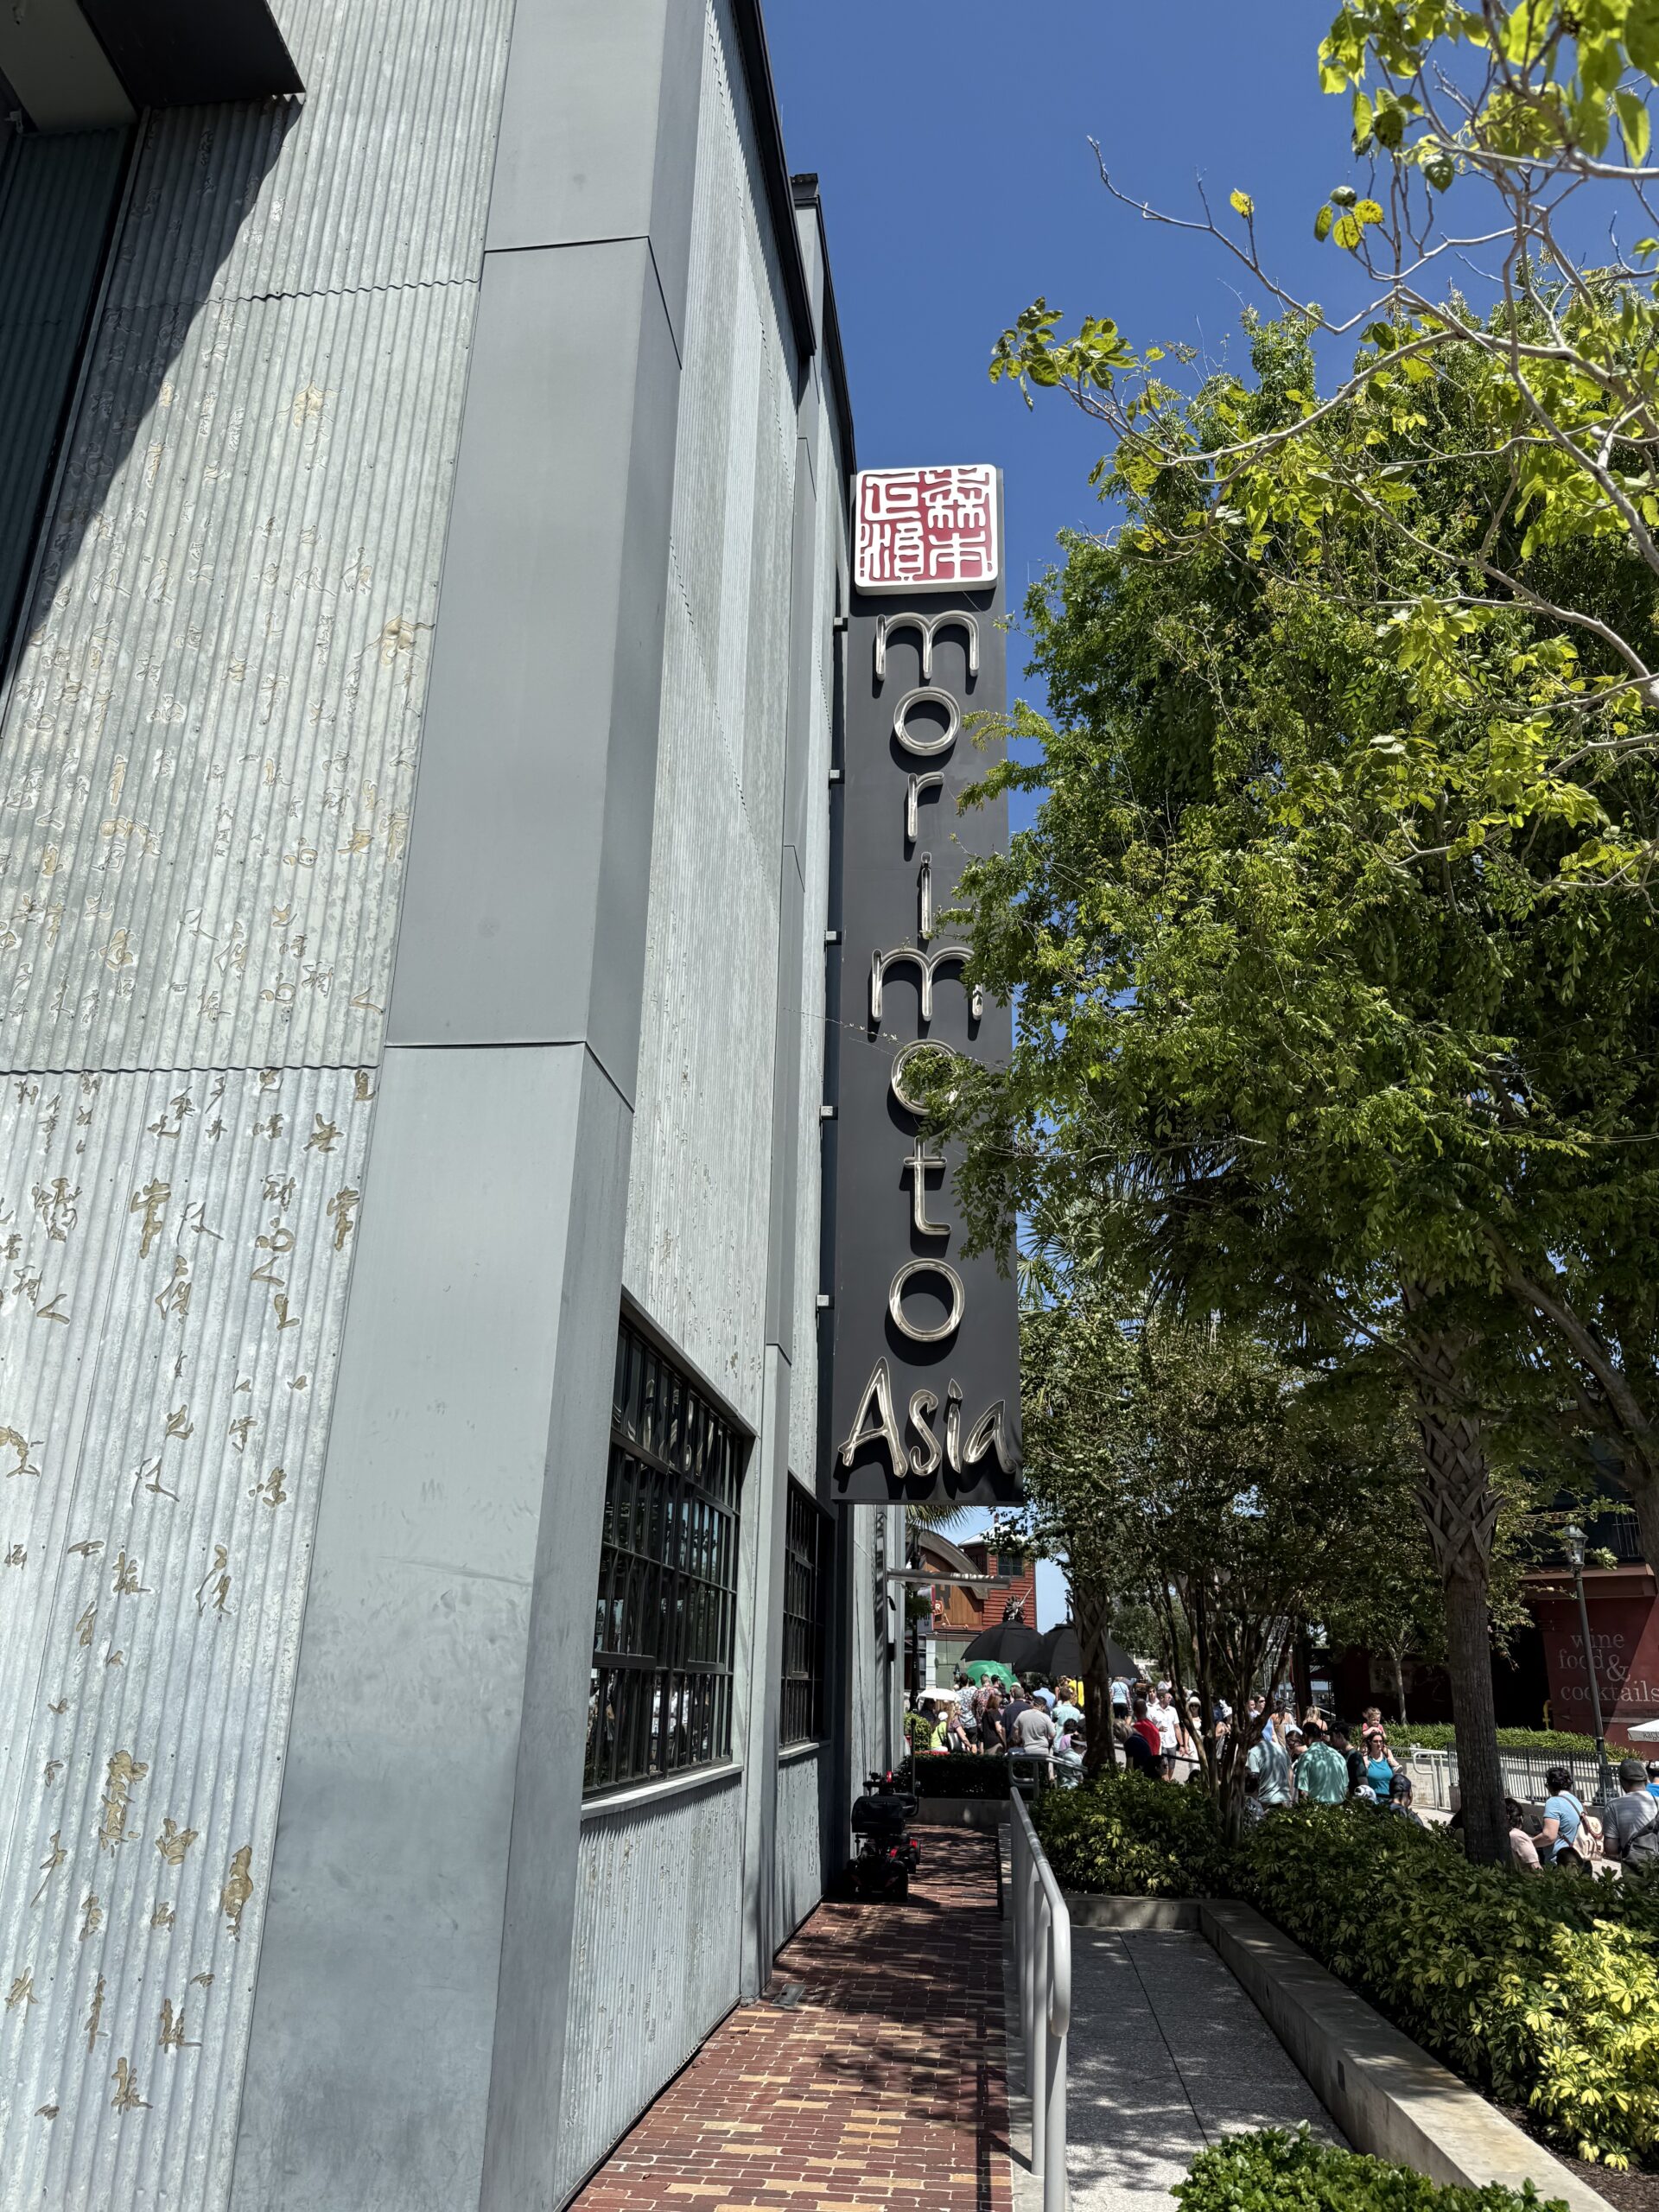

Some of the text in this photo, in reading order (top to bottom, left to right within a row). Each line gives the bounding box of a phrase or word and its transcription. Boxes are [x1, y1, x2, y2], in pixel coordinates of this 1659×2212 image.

[871, 609, 984, 1343] morimoto
[837, 1356, 1017, 1478] Asia
[1606, 1654, 1630, 1682] &
